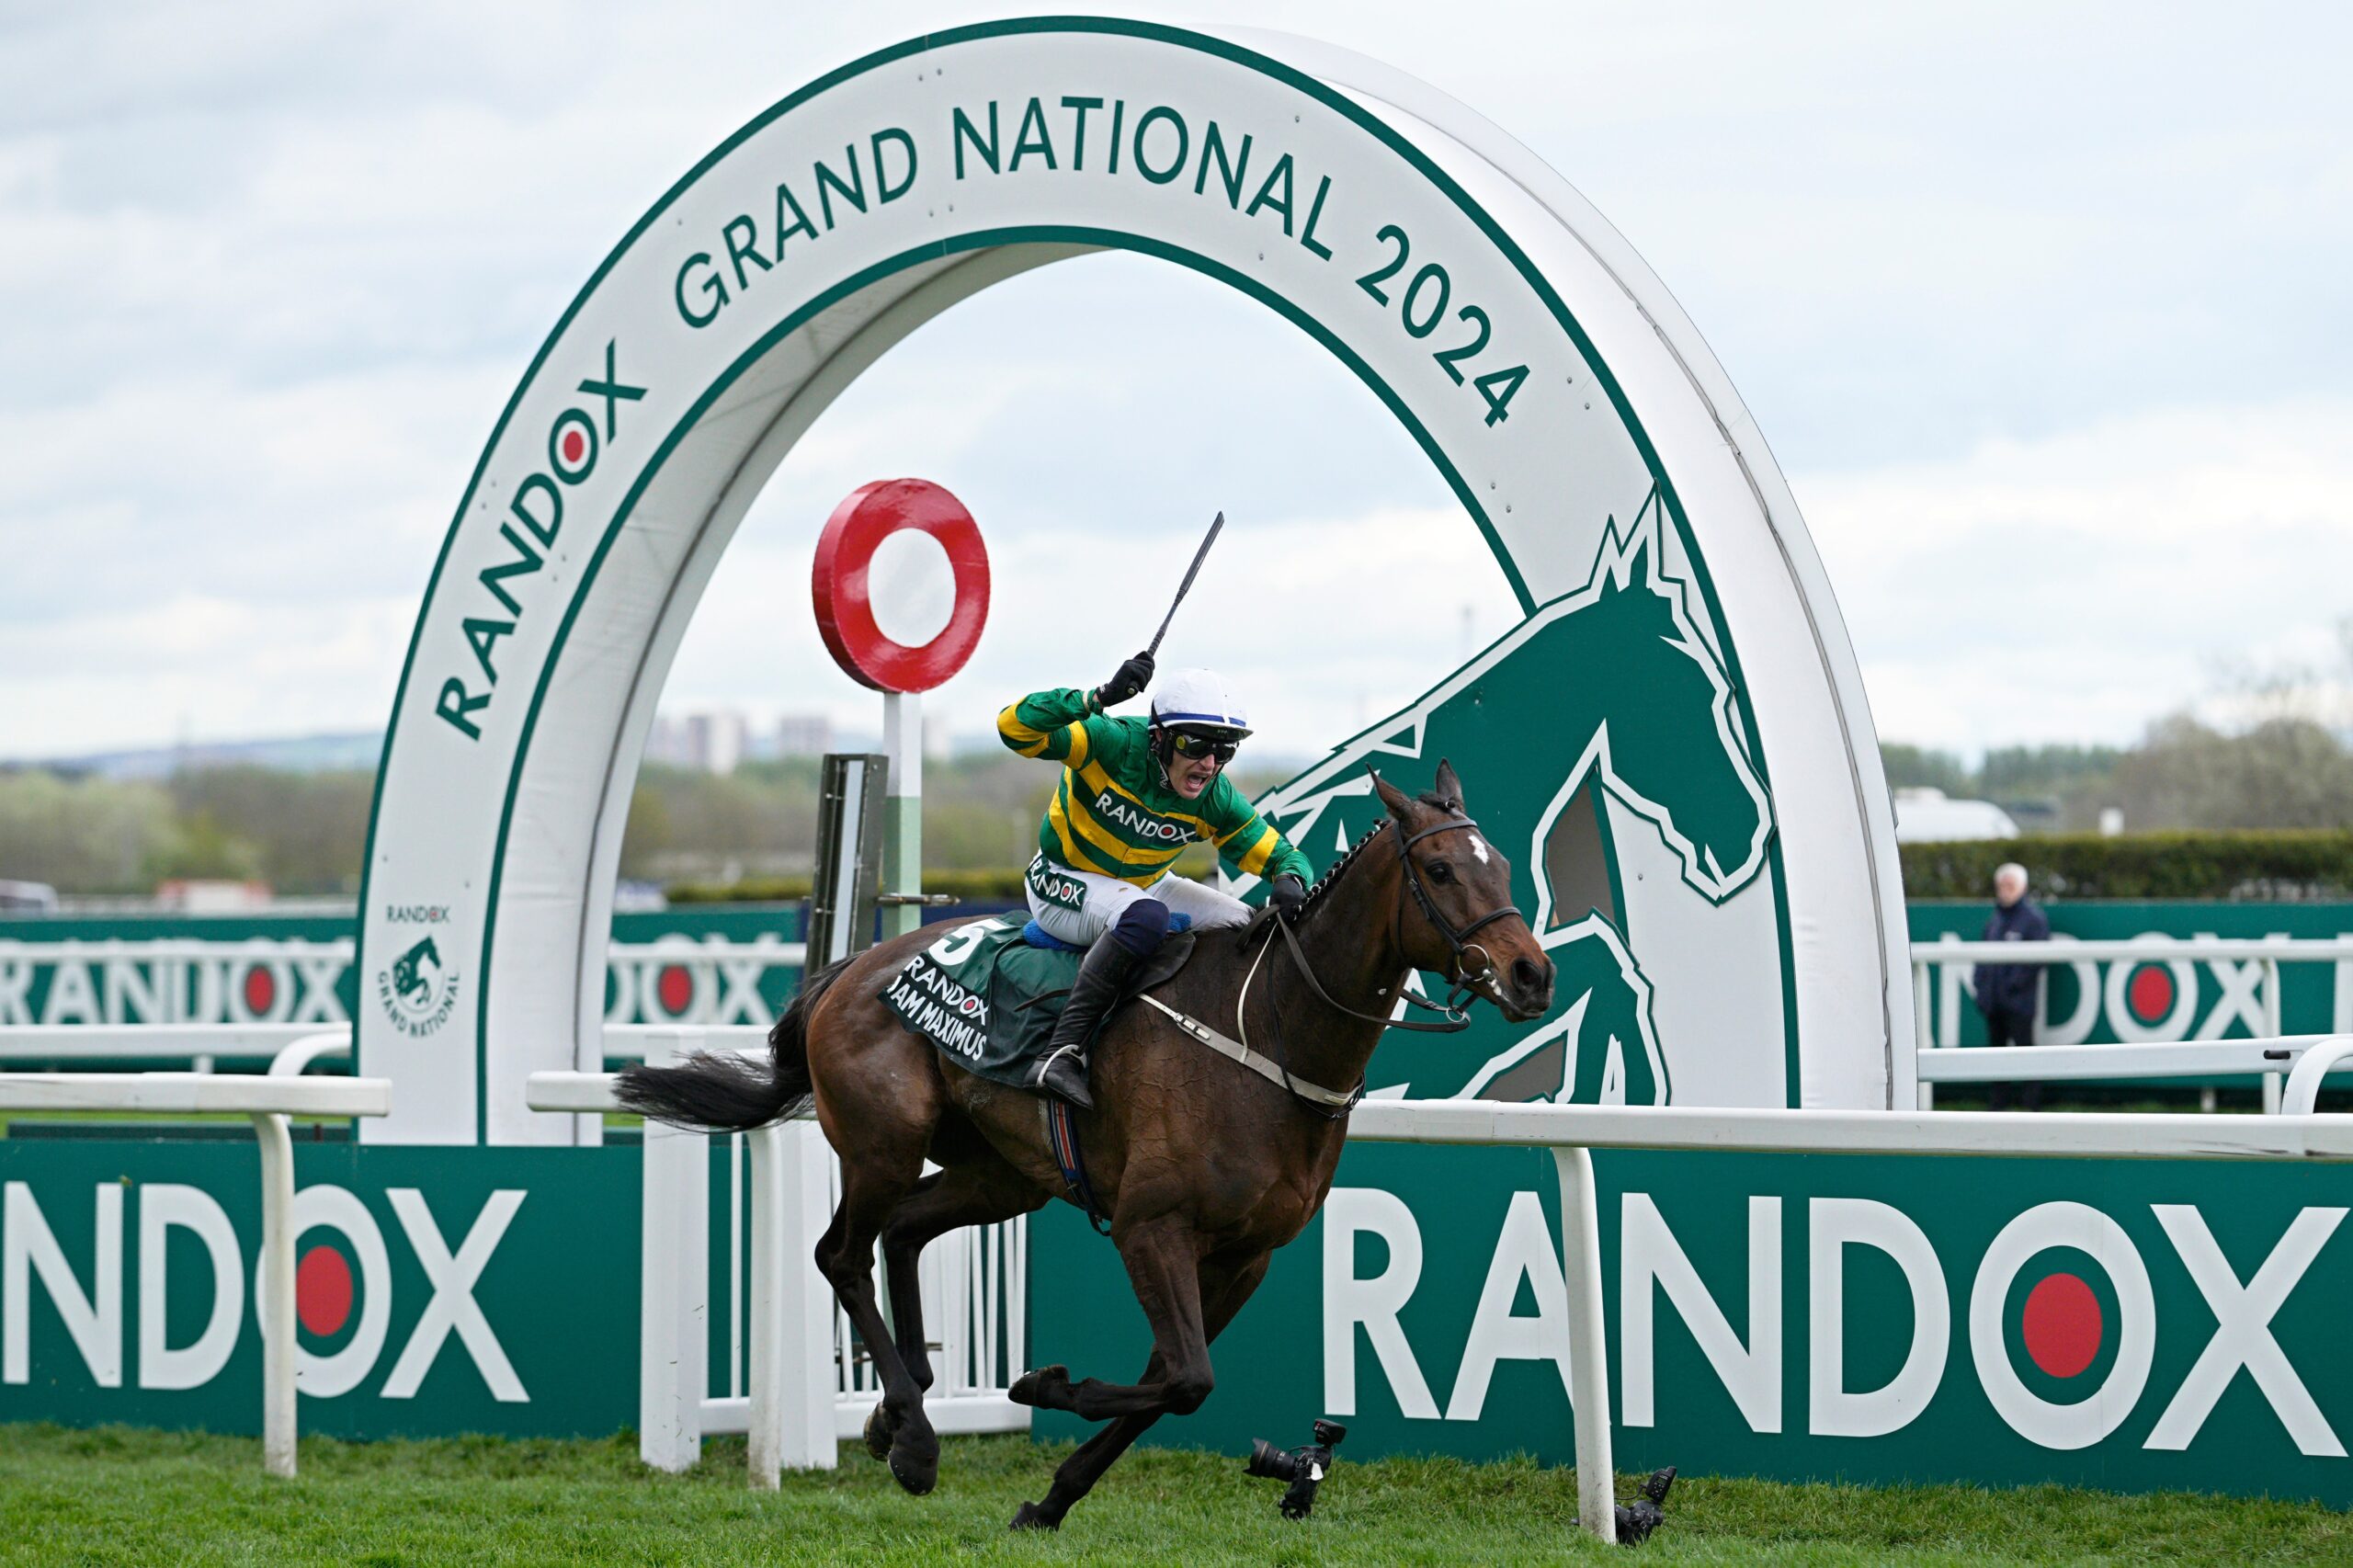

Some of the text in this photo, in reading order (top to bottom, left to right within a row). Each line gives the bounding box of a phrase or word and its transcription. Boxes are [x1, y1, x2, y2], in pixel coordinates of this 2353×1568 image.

[435, 96, 1531, 742] RANDOX GRAND NATIONAL 2024
[1095, 792, 1197, 844] RANDOX
[386, 905, 450, 923] RANDOX
[1029, 858, 1086, 906] RANDOX
[927, 918, 1011, 966] 5
[378, 971, 460, 1038] GRAND NATIONAL
[890, 983, 926, 1019] AM
[915, 1001, 988, 1062] MAXIMUS
[904, 955, 990, 1027] RANDOX
[2, 1179, 531, 1403] NDOX
[1322, 1187, 2353, 1458] RANDOX
